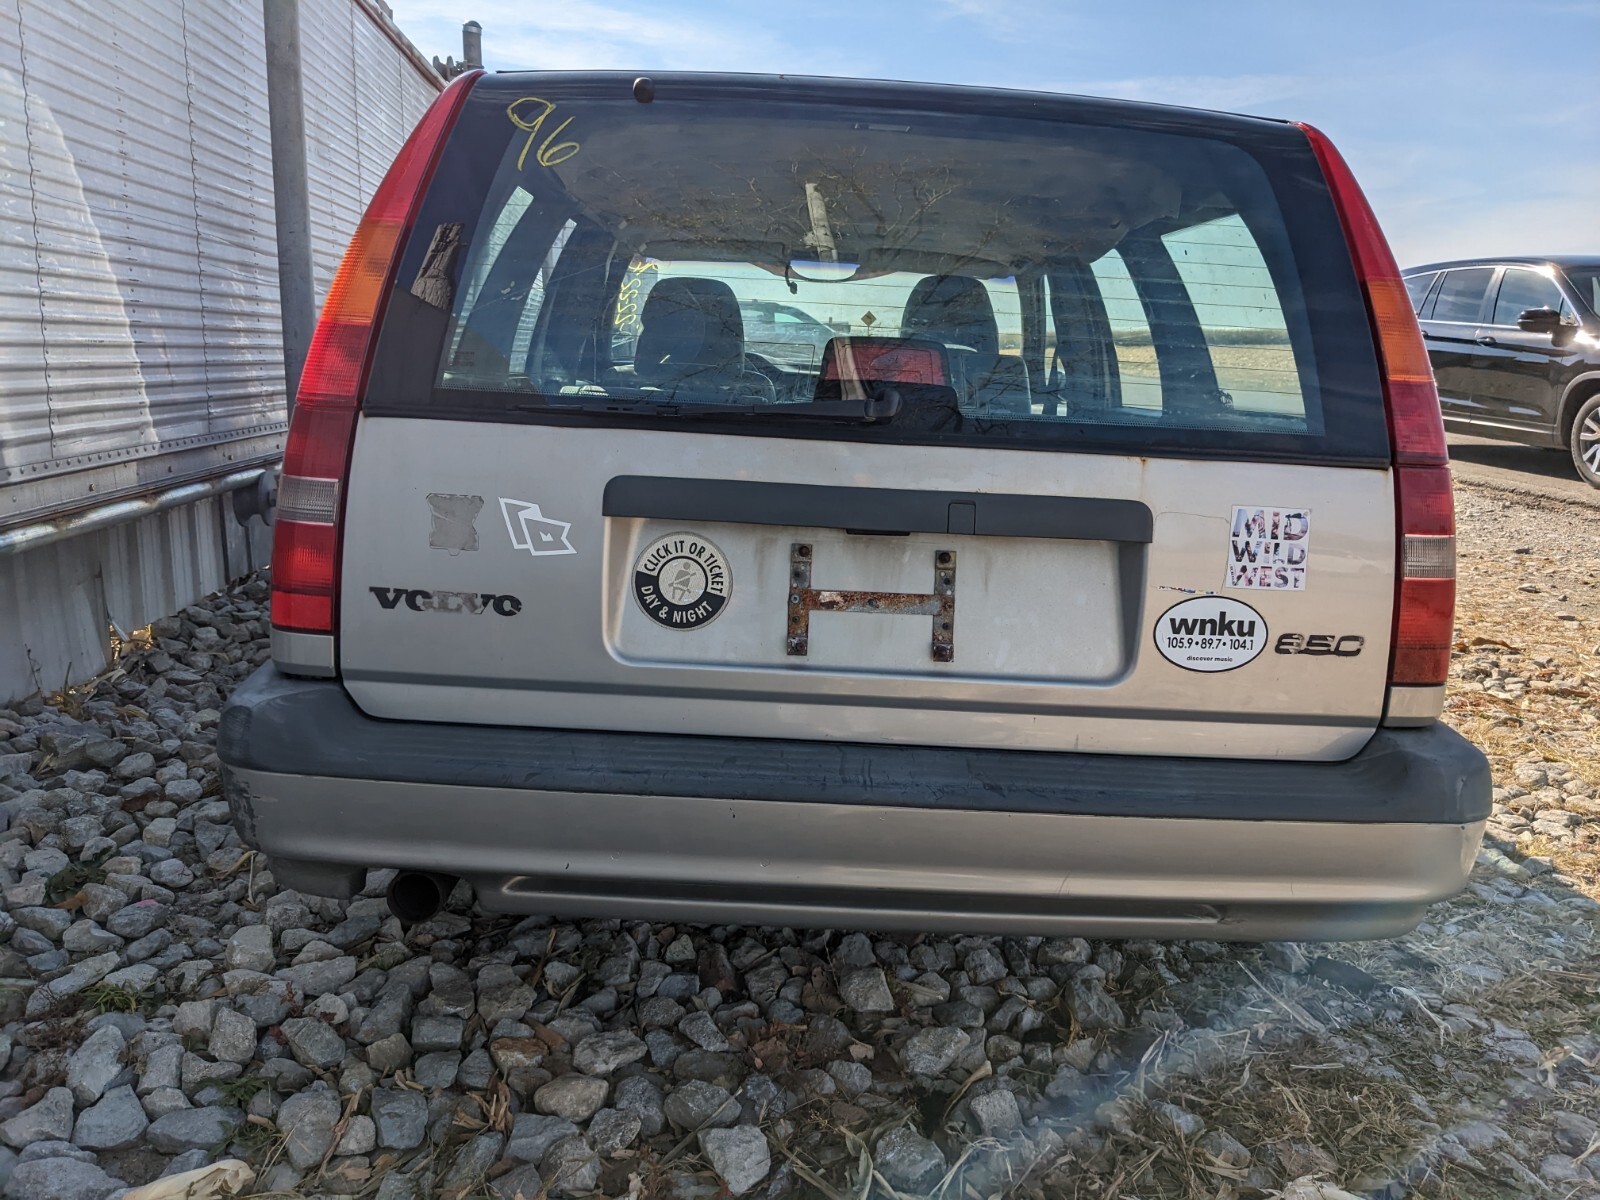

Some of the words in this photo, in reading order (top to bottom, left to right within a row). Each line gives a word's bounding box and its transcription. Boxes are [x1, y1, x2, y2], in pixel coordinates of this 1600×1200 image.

[506, 97, 580, 171] 96
[1232, 508, 1309, 541] MID
[644, 543, 673, 572] CLICK
[674, 540, 685, 553] IT
[689, 542, 706, 558] OR
[703, 552, 724, 594] TICKET
[1231, 540, 1307, 566] WILD
[1229, 564, 1305, 589] WEST
[641, 585, 661, 609] DAY
[658, 606, 669, 619] &
[672, 601, 713, 623] NIGHT
[1169, 611, 1256, 637] wnku
